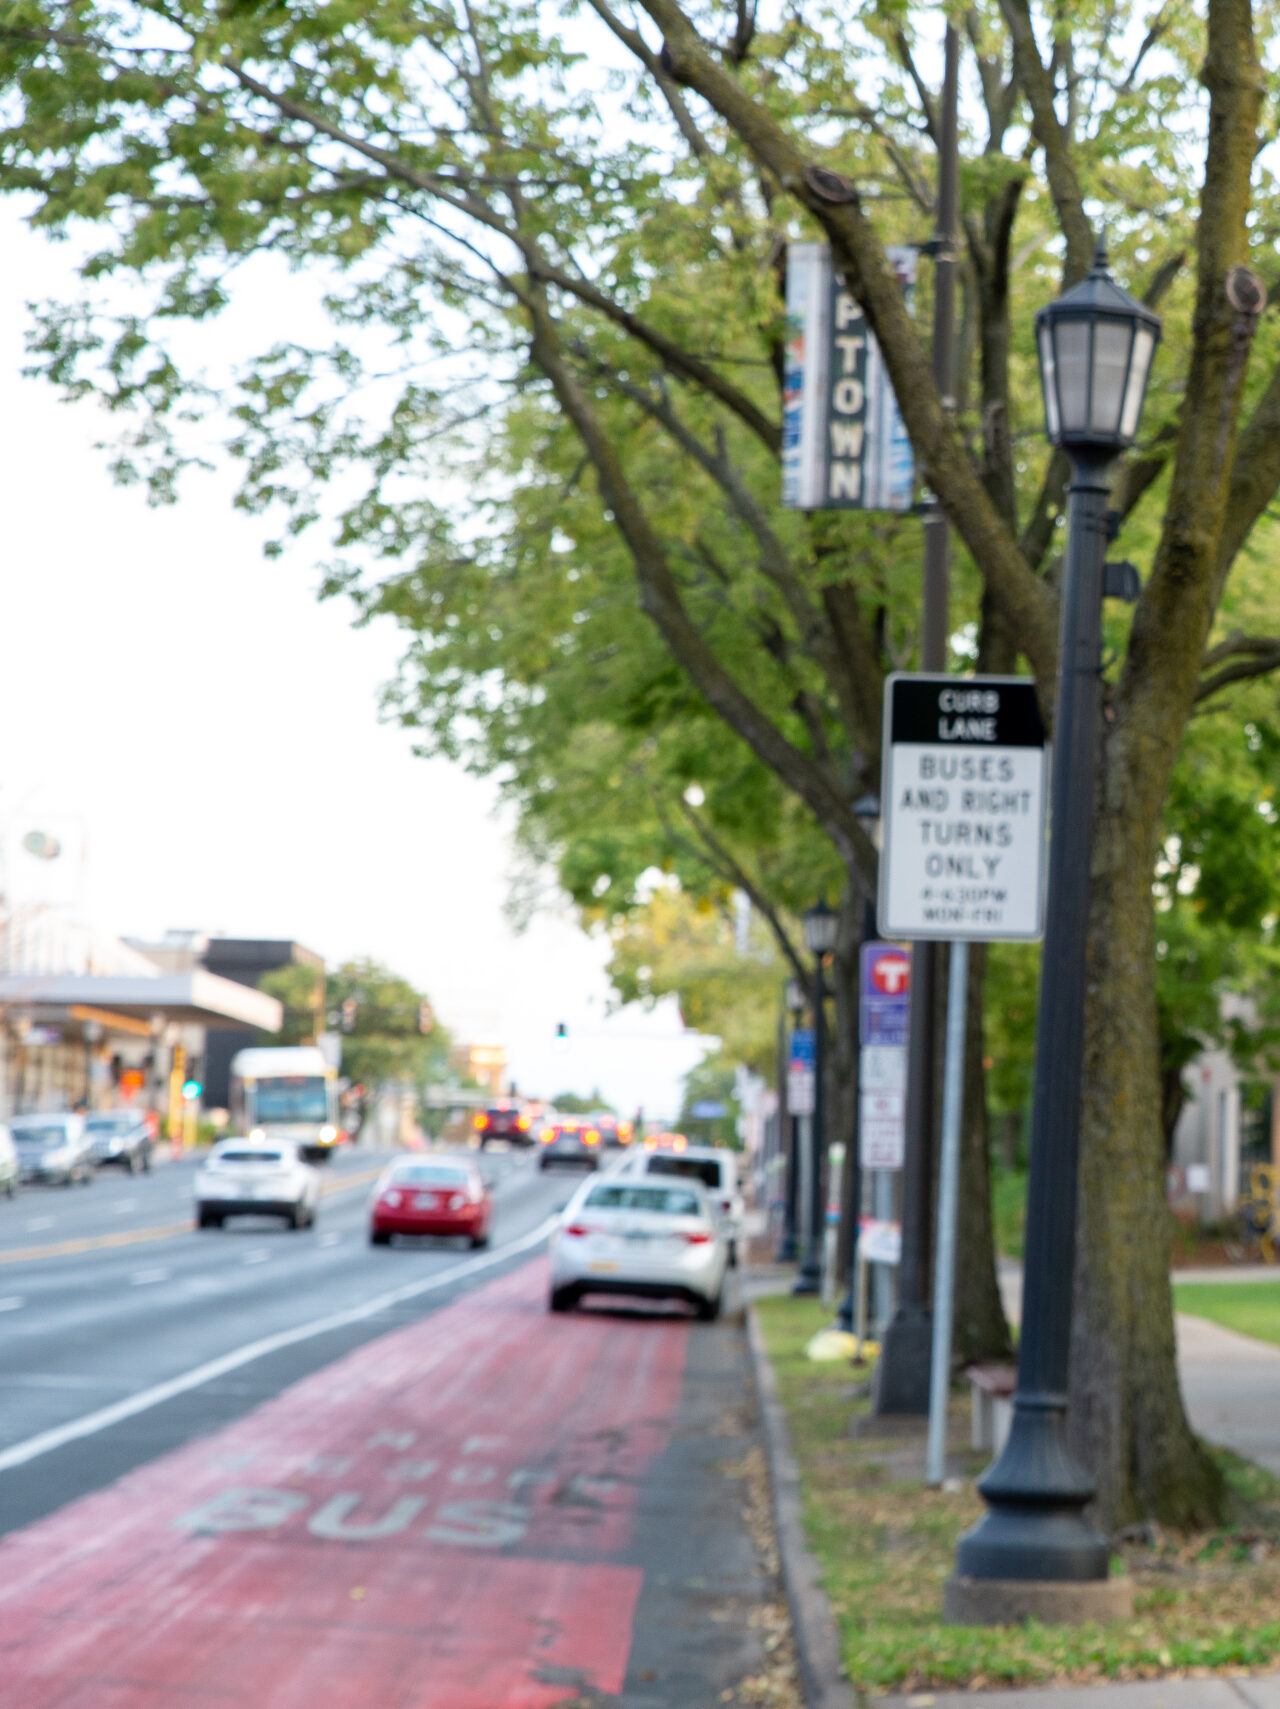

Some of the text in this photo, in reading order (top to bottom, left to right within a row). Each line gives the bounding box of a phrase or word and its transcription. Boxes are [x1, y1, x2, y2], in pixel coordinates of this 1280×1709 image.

[831, 270, 867, 500] PTOWN
[938, 689, 1000, 714] CURB
[938, 717, 997, 741] LANE
[919, 754, 1014, 782] BUSES
[901, 788, 1032, 815] AND RIGHT
[920, 819, 1012, 848] TURNS
[924, 854, 1002, 879] ONLY
[170, 1487, 531, 1547] BUS
